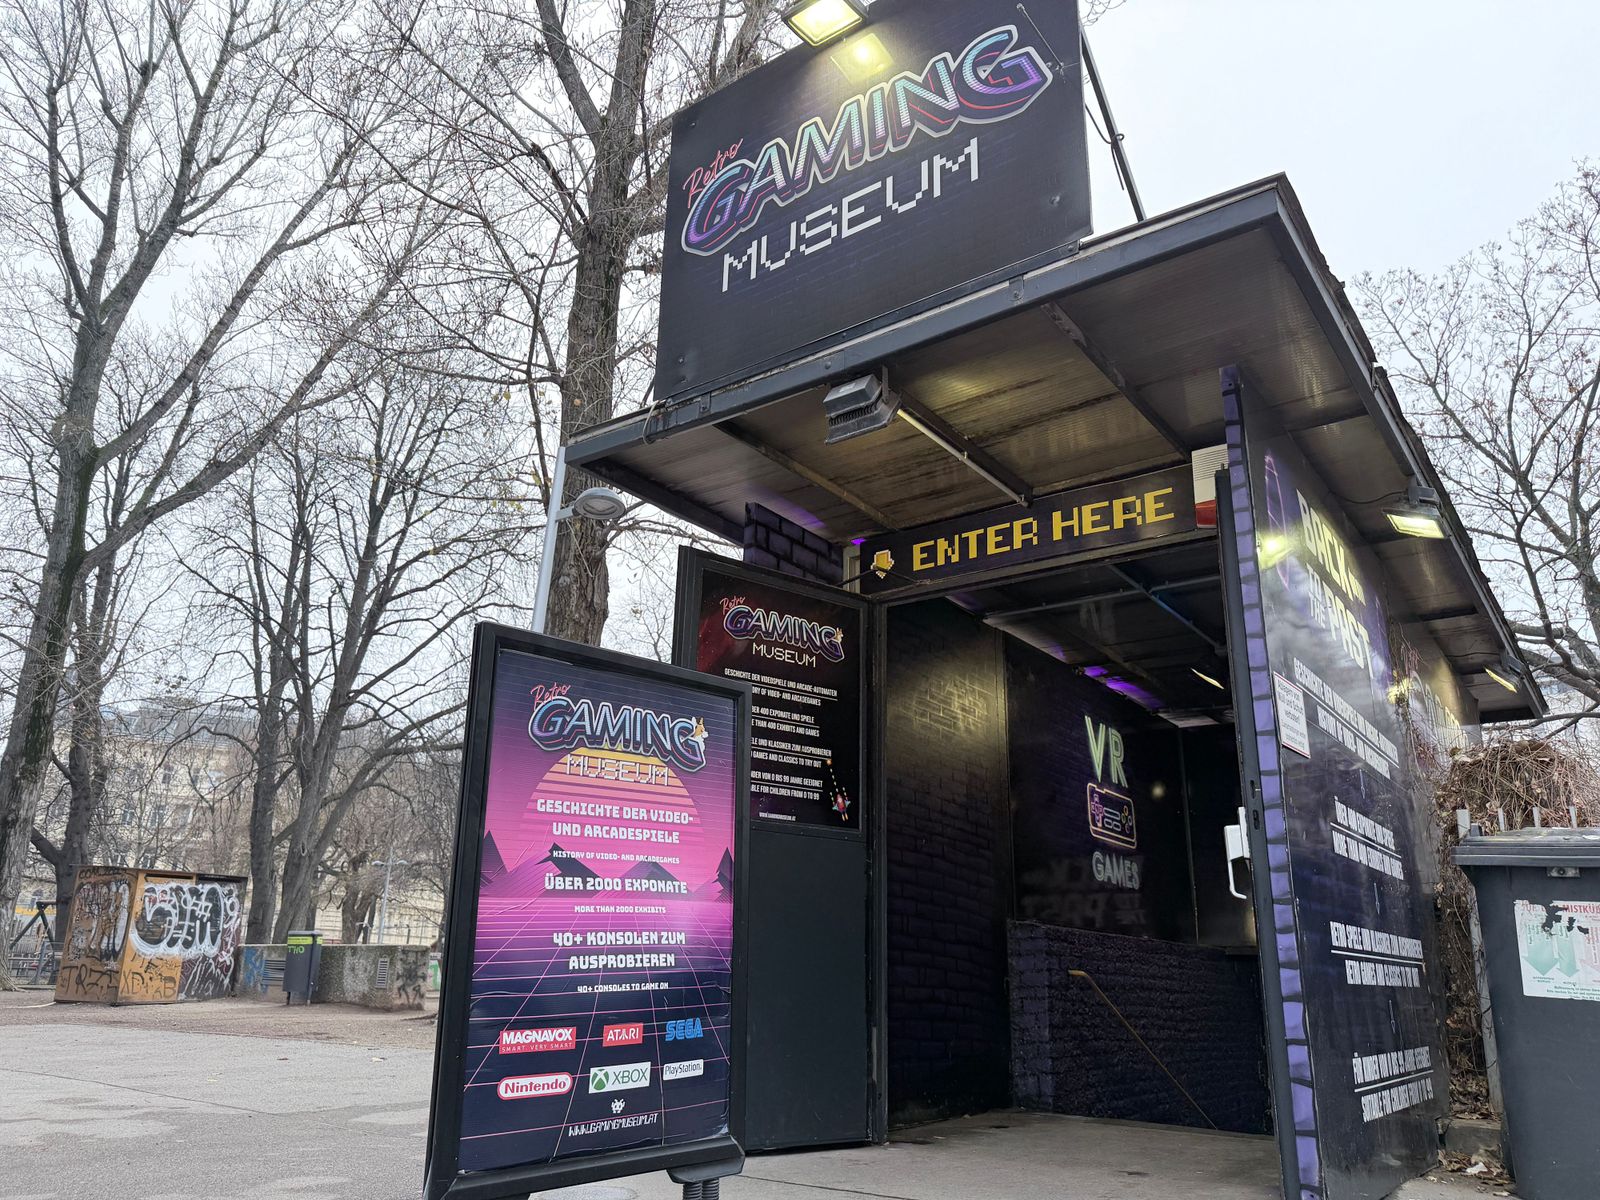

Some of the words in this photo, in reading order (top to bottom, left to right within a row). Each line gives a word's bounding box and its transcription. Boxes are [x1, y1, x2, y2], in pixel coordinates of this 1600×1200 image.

[682, 25, 1053, 256] GAMING
[682, 138, 743, 208] Retro
[721, 137, 980, 292] MUSEUM
[912, 517, 1039, 571] ENTER
[1052, 487, 1175, 541] HERE
[719, 595, 746, 615] Retro
[724, 605, 845, 662] GAMING
[1323, 580, 1374, 680] PAST
[752, 642, 817, 668] MUSEUM
[724, 668, 751, 680] GESCHICHTE
[752, 673, 760, 681] DER
[761, 675, 787, 687] VIDEOSPIELE
[530, 682, 571, 709] Retro
[782, 692, 791, 700] AND
[760, 707, 769, 715] 400
[800, 714, 815, 723] SPIELE
[528, 696, 706, 773] GAMING
[755, 719, 767, 728] THAN
[767, 721, 776, 730] 400
[805, 728, 820, 737] GAMES
[778, 755, 798, 764] CLASSICS
[1085, 715, 1128, 788] VR
[566, 753, 669, 786] MUSEUM
[760, 785, 769, 793] FOR
[770, 786, 790, 796] CHILDREN
[814, 792, 820, 801] 99
[536, 799, 620, 819] GESCHICHTE
[622, 806, 647, 821] DER
[650, 809, 694, 825] VIDEO-
[552, 822, 581, 837] UND
[584, 824, 680, 844] ARCADESPIELE
[553, 850, 584, 859] HISTORY
[586, 851, 594, 859] OF
[596, 852, 620, 861] VIDEO-
[635, 854, 680, 864] ARCADEGAMES
[1092, 850, 1140, 890] GAMES
[544, 873, 584, 891] ÜBER
[586, 877, 622, 891] 2000
[625, 878, 688, 894] EXPONATE
[574, 905, 595, 914] MORE
[596, 905, 615, 914] THAN
[635, 906, 666, 914] EXHIBITS
[553, 932, 583, 947] 40+
[587, 931, 658, 946] KONSOLEN
[660, 932, 685, 945] ZUM
[569, 953, 675, 970] AUSPROBIEREN
[577, 985, 593, 993] 40+
[594, 984, 630, 992] CONSOLES
[631, 983, 640, 991] TO
[641, 983, 659, 991] GAME
[660, 982, 668, 990] ON
[502, 1028, 573, 1045] MAGNAVOX
[607, 1027, 639, 1041] ATARI
[665, 1018, 703, 1041] SEGA
[612, 1068, 648, 1085] XBOX
[664, 1062, 702, 1076] PlayStation
[504, 1078, 567, 1094] Nintendo
